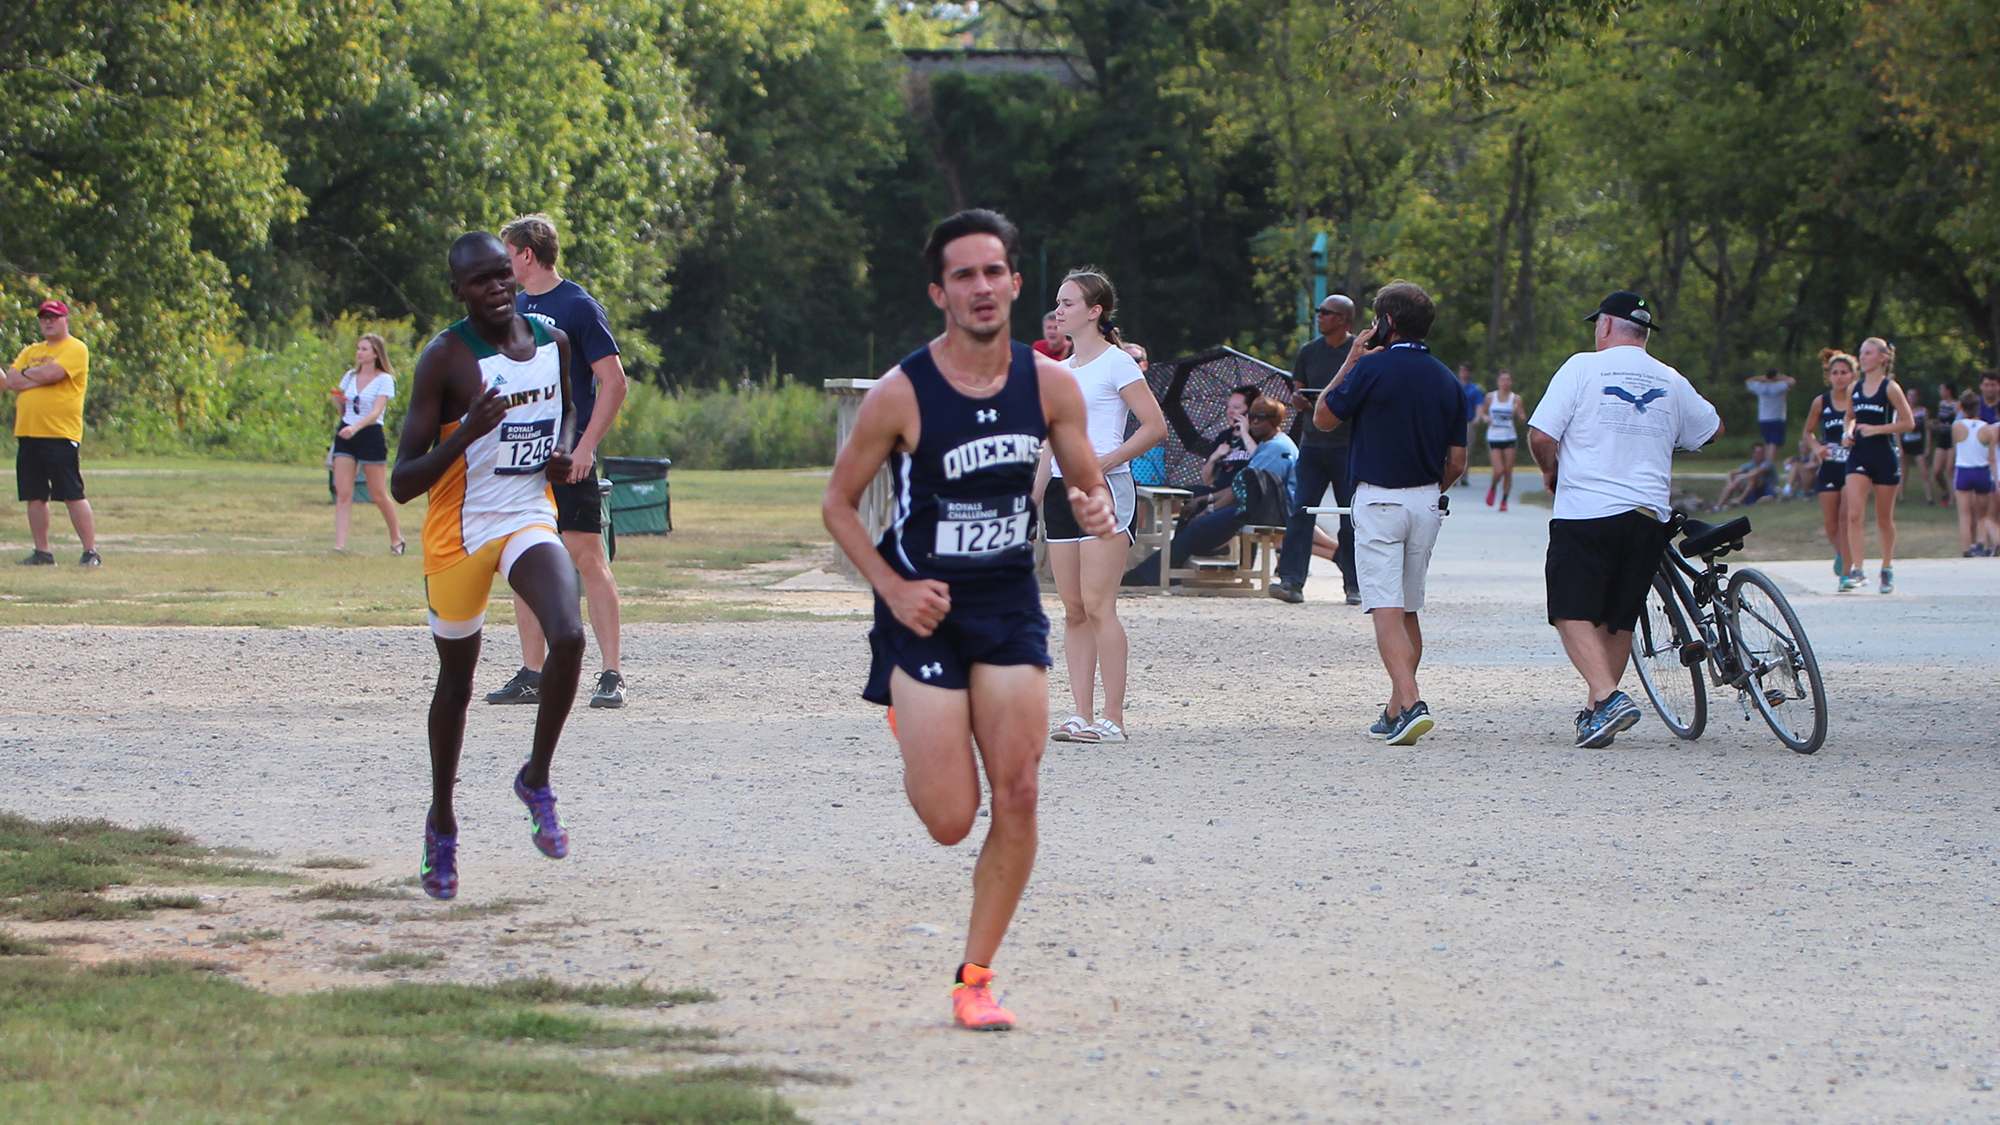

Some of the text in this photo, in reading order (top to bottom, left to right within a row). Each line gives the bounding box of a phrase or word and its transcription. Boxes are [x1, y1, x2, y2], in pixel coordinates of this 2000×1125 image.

[1825, 419, 1844, 428] CATA
[508, 425, 534, 433] ROYALS
[507, 430, 542, 440] CHALLENGE
[511, 436, 554, 466] 1248
[943, 433, 1040, 480] QUEENS
[947, 502, 983, 511] ROYALS
[947, 509, 998, 519] CHALLENGE
[955, 516, 1017, 552] 1225
